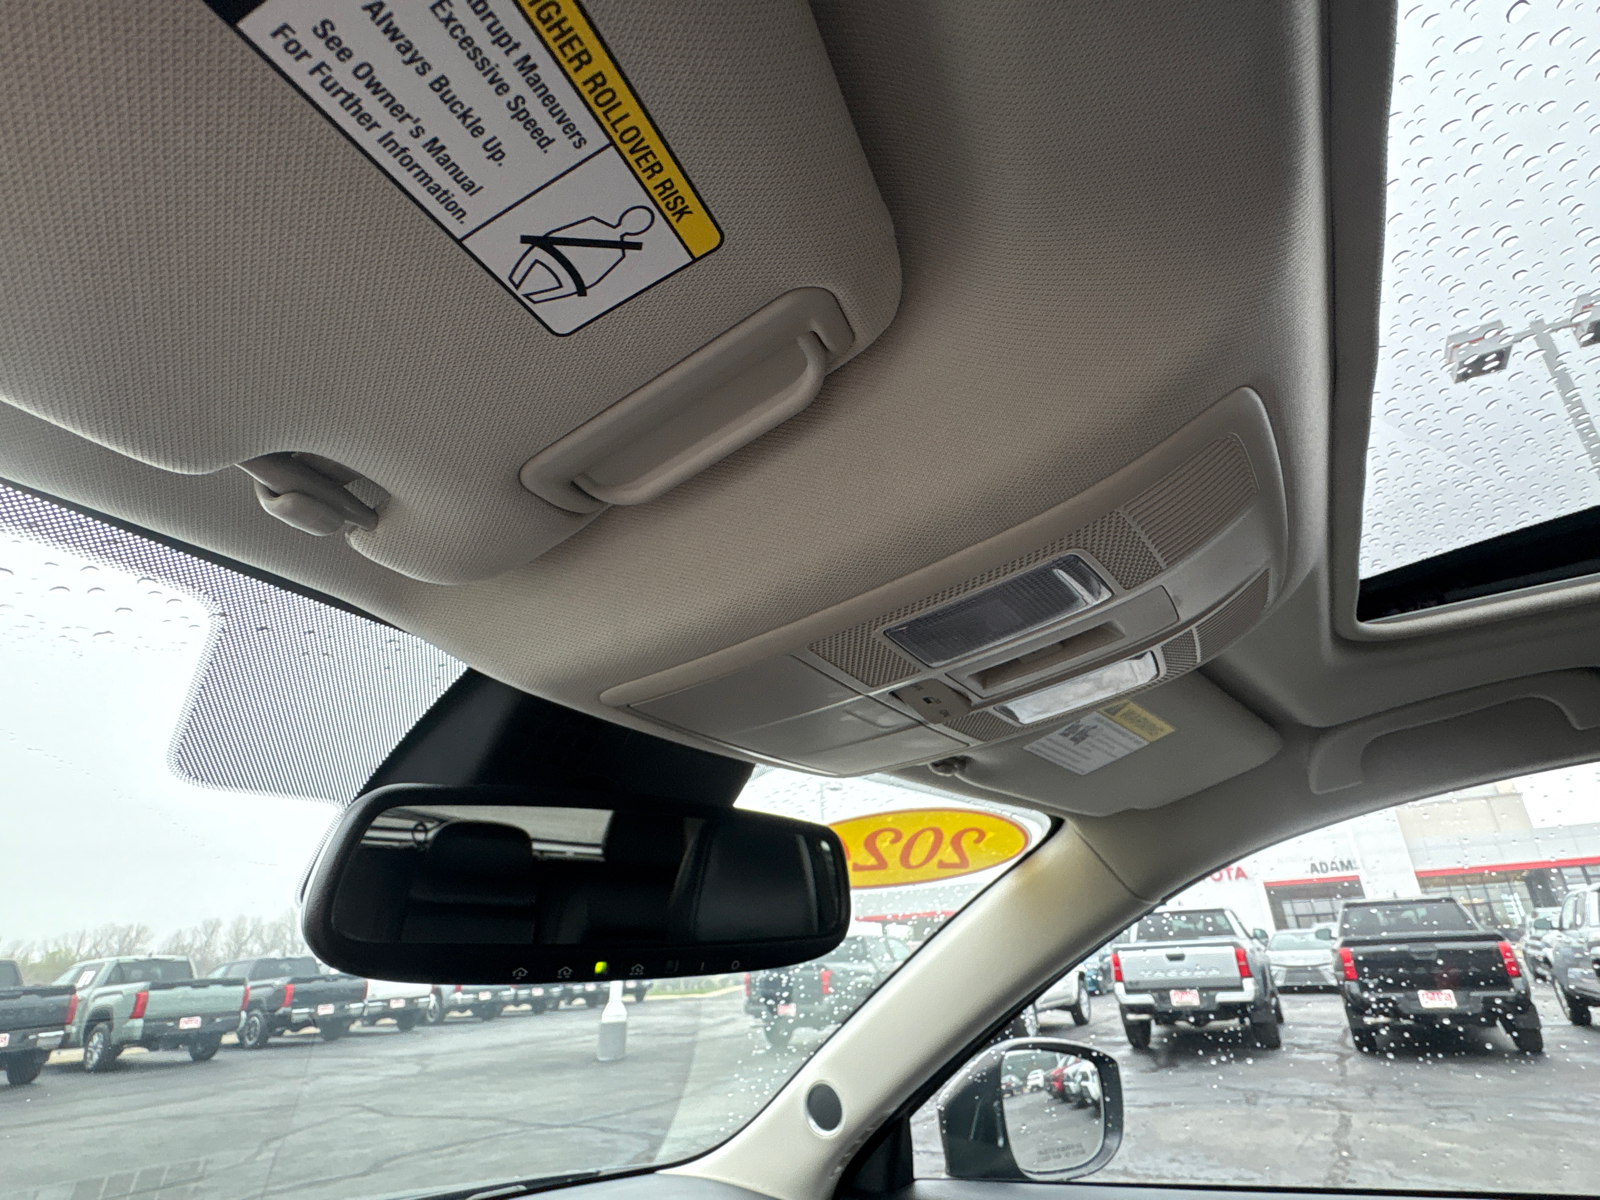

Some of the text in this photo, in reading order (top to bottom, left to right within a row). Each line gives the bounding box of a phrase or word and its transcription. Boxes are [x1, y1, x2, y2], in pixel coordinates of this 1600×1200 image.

[270, 22, 468, 225] For Further Information.
[312, 18, 484, 197] See Owner's Manual
[361, 0, 507, 167] Always Buckle Up.
[430, 0, 556, 154] Excessive Speed.
[467, 0, 587, 149] brupt Maneuvers
[582, 71, 664, 180] ROLLOVER
[653, 178, 693, 223] RISK
[1208, 865, 1249, 882] OTA
